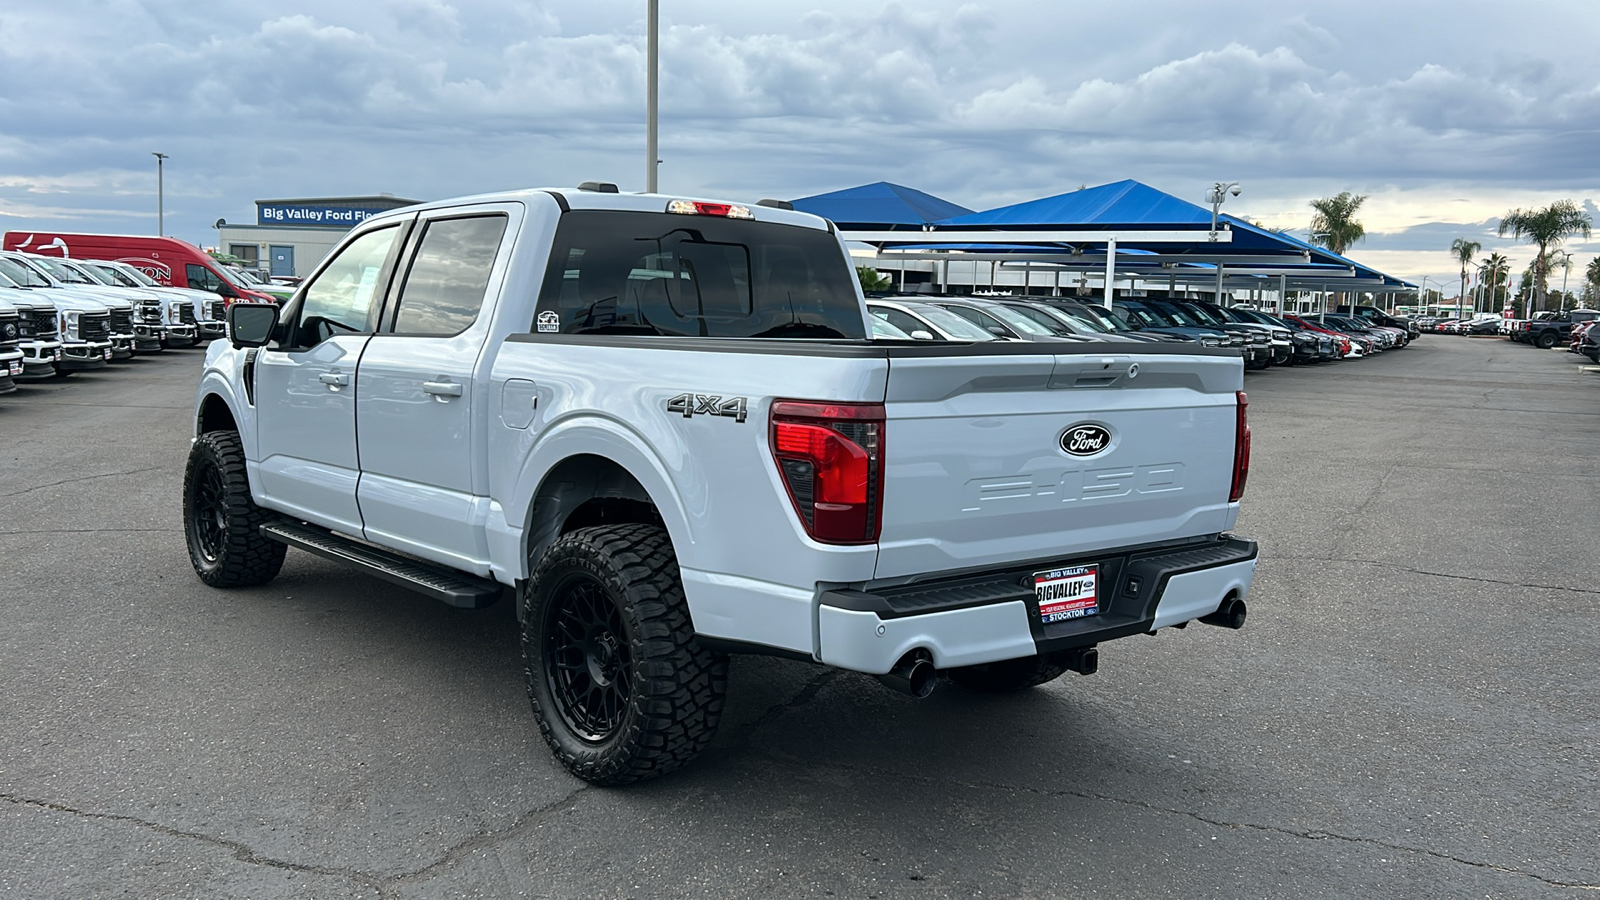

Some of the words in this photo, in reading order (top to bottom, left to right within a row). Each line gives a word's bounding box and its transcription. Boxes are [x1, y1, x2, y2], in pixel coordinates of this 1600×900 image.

[263, 208, 284, 220] Big
[285, 208, 323, 221] Valley
[325, 210, 352, 220] Ford
[354, 210, 379, 220] Fle
[1070, 429, 1103, 450] Ford
[962, 462, 1185, 511] F-150
[1050, 570, 1061, 578] BIG
[1062, 568, 1084, 576] VALLEY
[1037, 581, 1083, 601] BIGVALLEY
[1050, 609, 1084, 620] STOCKTON
